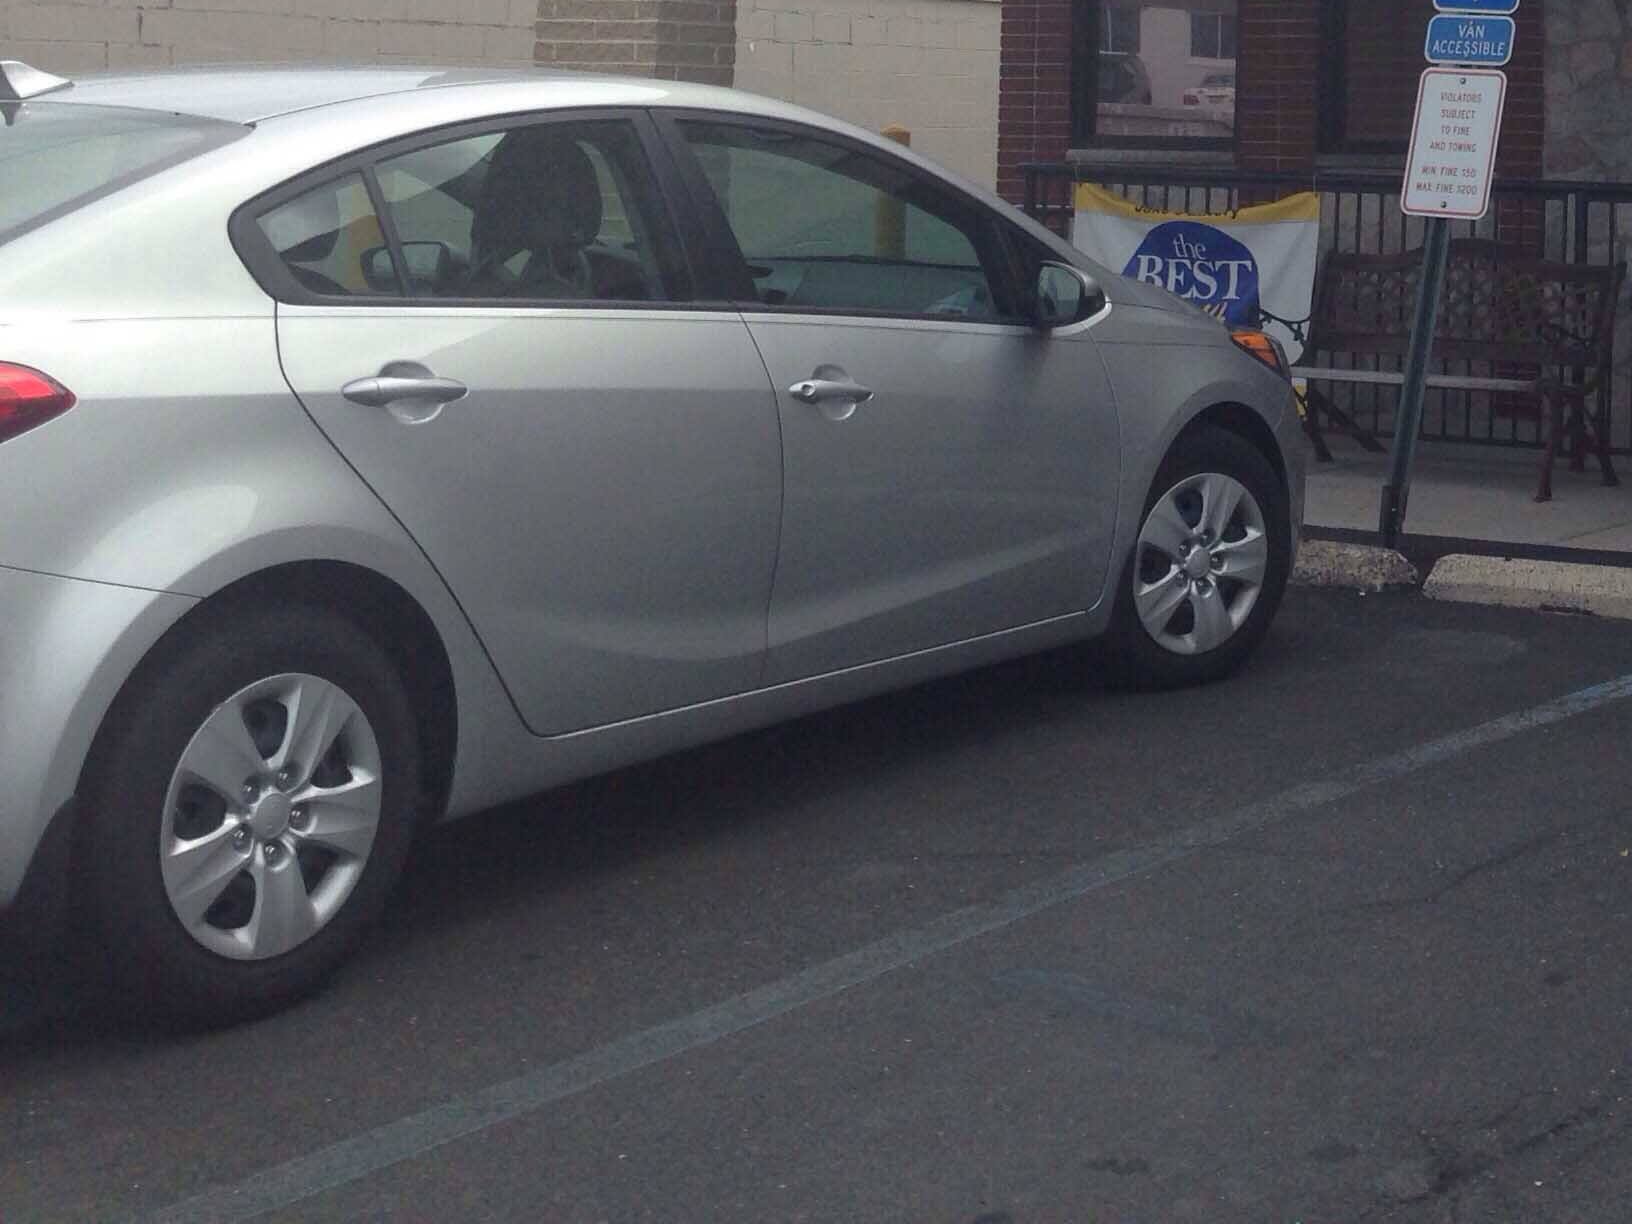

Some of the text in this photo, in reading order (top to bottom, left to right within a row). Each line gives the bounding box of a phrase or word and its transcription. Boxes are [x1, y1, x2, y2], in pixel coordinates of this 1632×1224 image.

[1458, 24, 1486, 39] VAN
[1431, 39, 1506, 57] ACCESSIBLE
[1440, 91, 1483, 104] VIOLATORS
[1440, 108, 1476, 120] SUBJECT
[1441, 125, 1473, 137] TO FINE
[1448, 142, 1478, 154] TOWING
[1435, 183, 1455, 194] FINE
[1173, 233, 1207, 261] the
[1136, 255, 1253, 301] BEST
